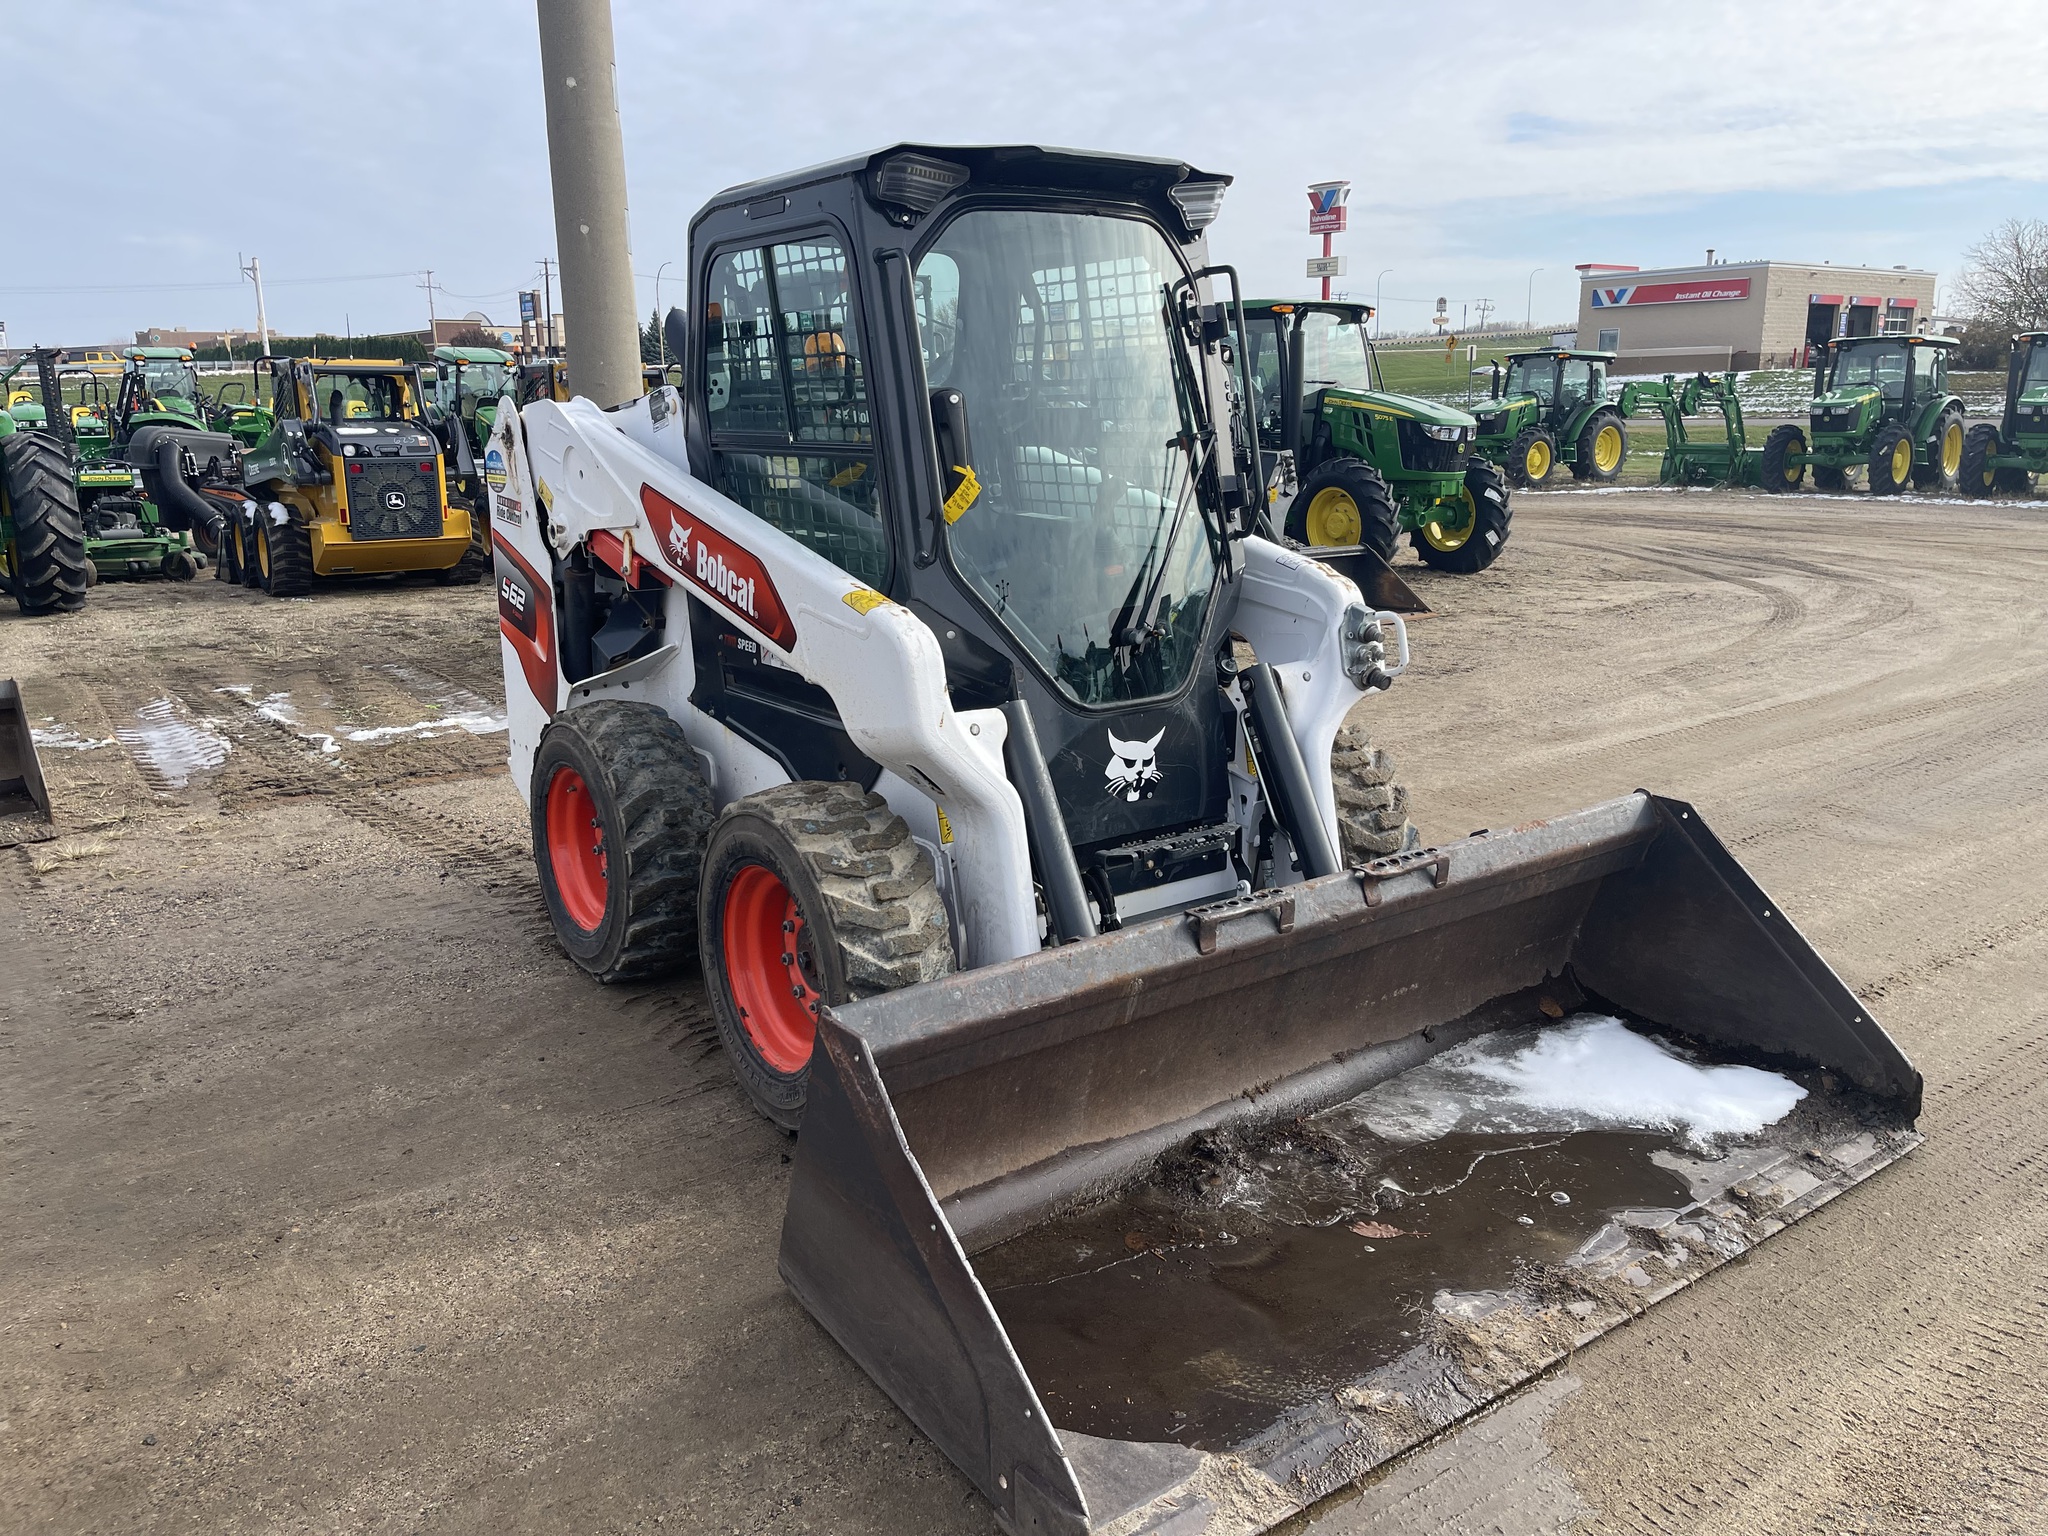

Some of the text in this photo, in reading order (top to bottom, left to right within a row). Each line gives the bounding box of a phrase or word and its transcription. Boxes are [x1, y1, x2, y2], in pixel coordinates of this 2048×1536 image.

[1311, 214, 1337, 222] Valvoline
[1674, 292, 1700, 300] Instant
[1712, 290, 1741, 298] Change
[497, 505, 521, 525] Ride Control
[696, 540, 755, 616] Bobcat
[501, 576, 526, 612] S62
[737, 637, 757, 653] SPEED
